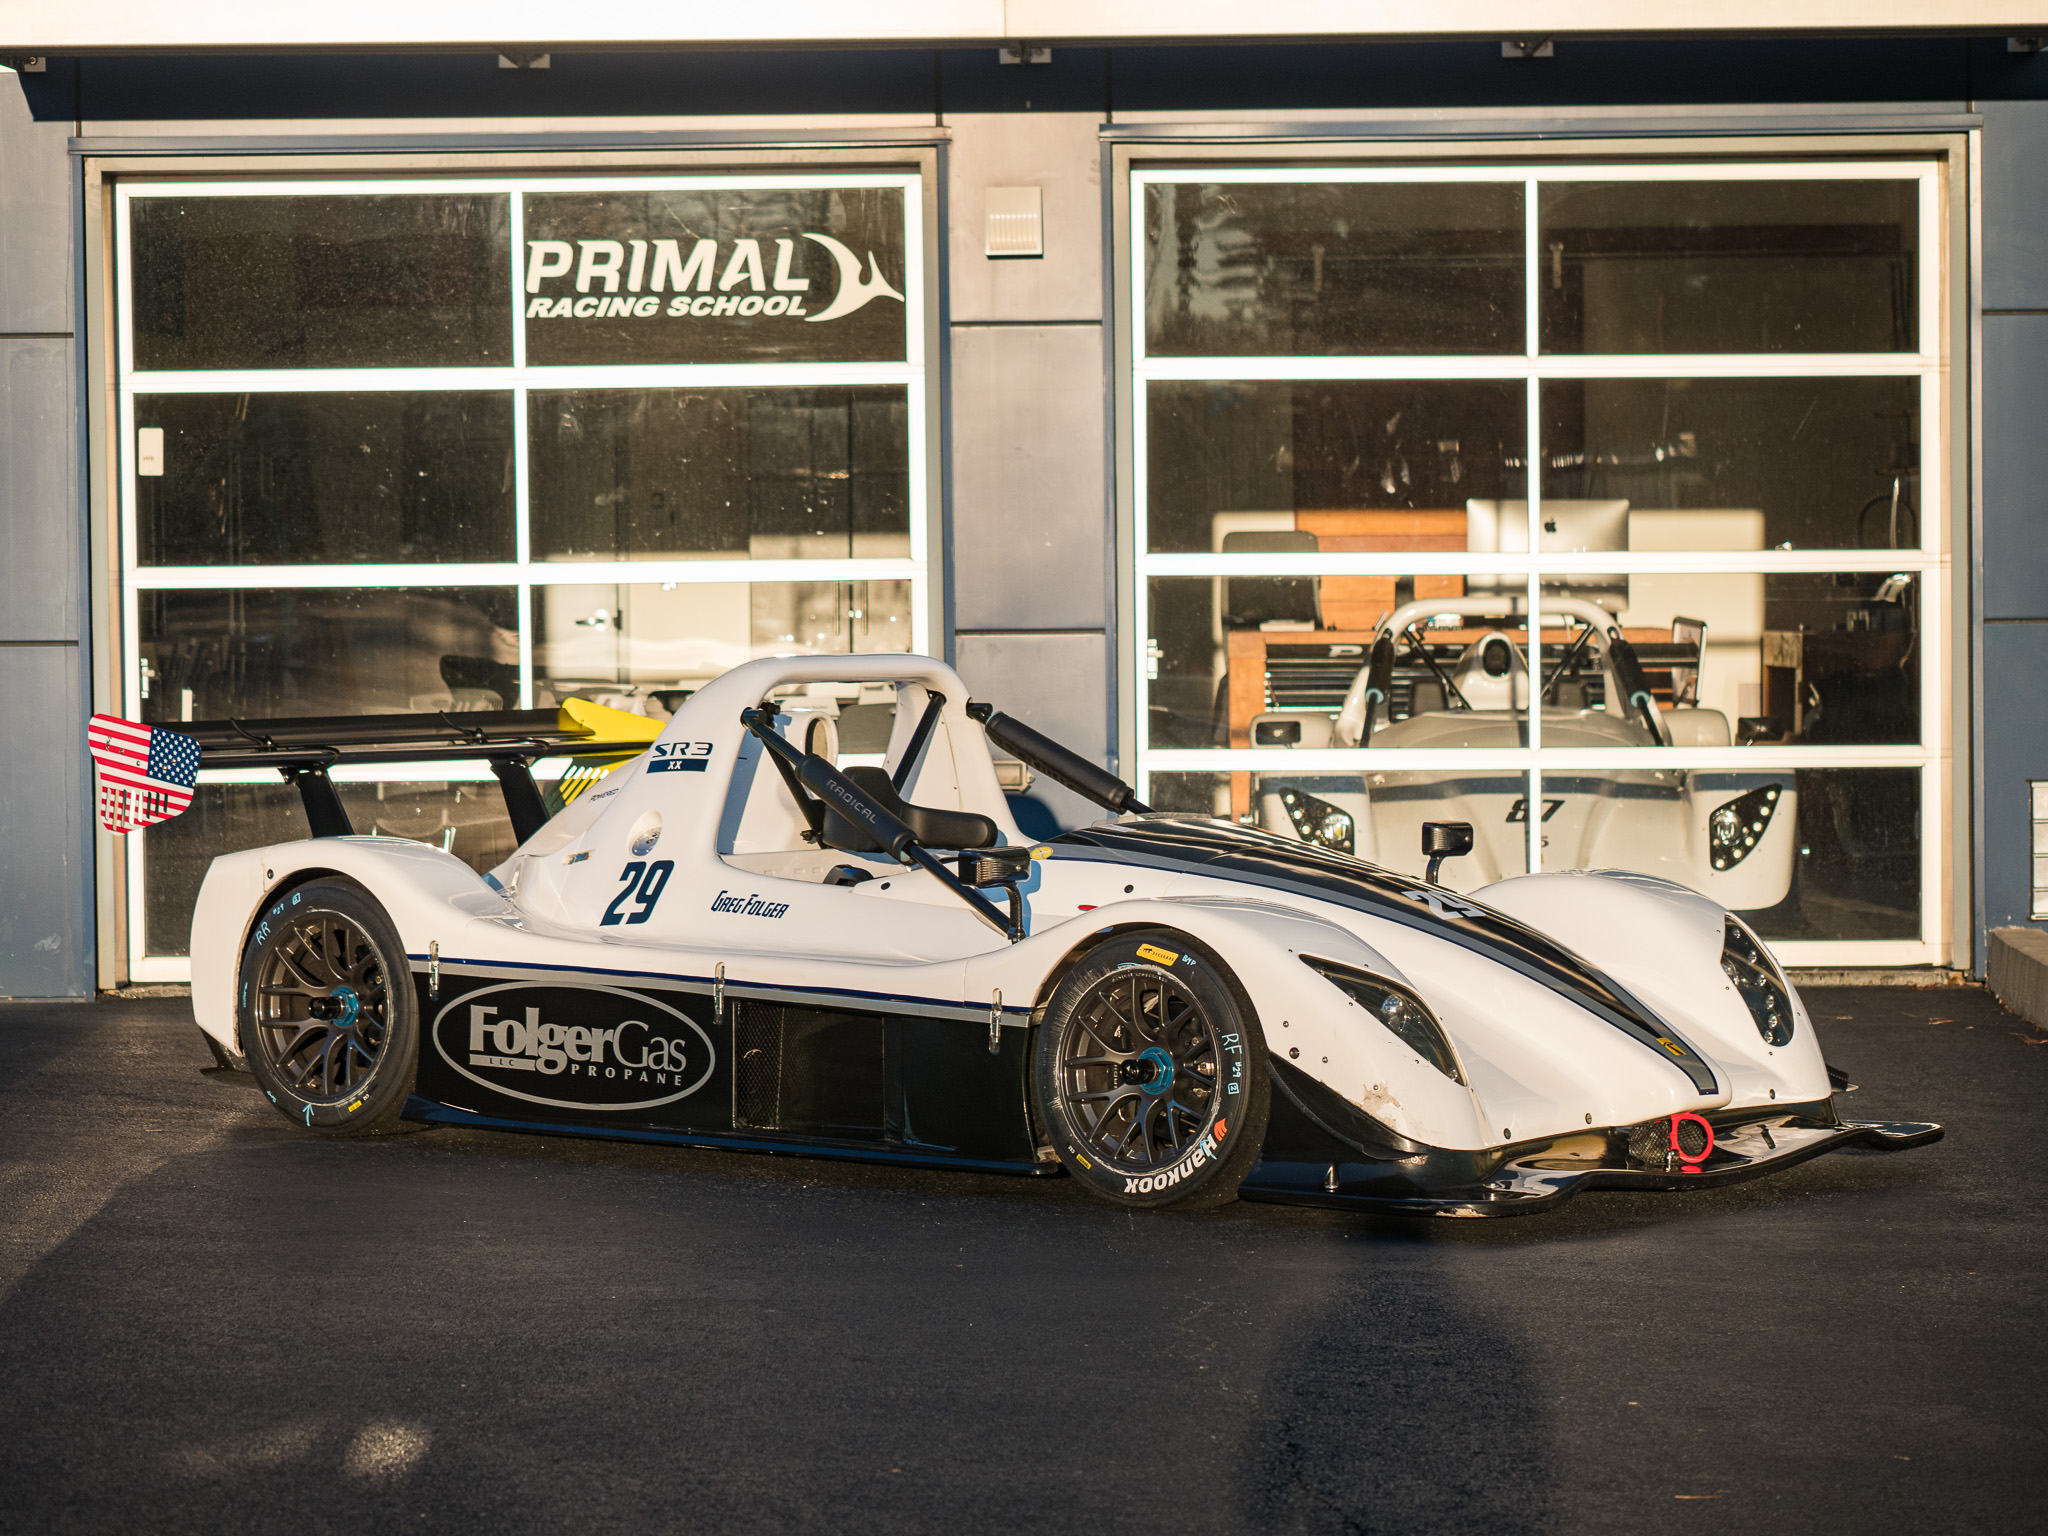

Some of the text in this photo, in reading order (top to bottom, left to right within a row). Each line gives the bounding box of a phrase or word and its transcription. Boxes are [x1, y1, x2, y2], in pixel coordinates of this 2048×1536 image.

[526, 239, 810, 293] PRIMAL
[526, 295, 807, 318] RACING SCHOOL
[652, 741, 714, 758] SR3
[667, 760, 683, 770] XX
[826, 779, 876, 824] RADICAL
[1505, 799, 1566, 823] 87
[600, 860, 675, 926] 29
[1401, 890, 1487, 920] 29
[255, 921, 271, 946] RR
[1221, 1033, 1243, 1055] RF
[489, 1056, 516, 1067] LLC
[571, 1063, 683, 1087] PROPANE
